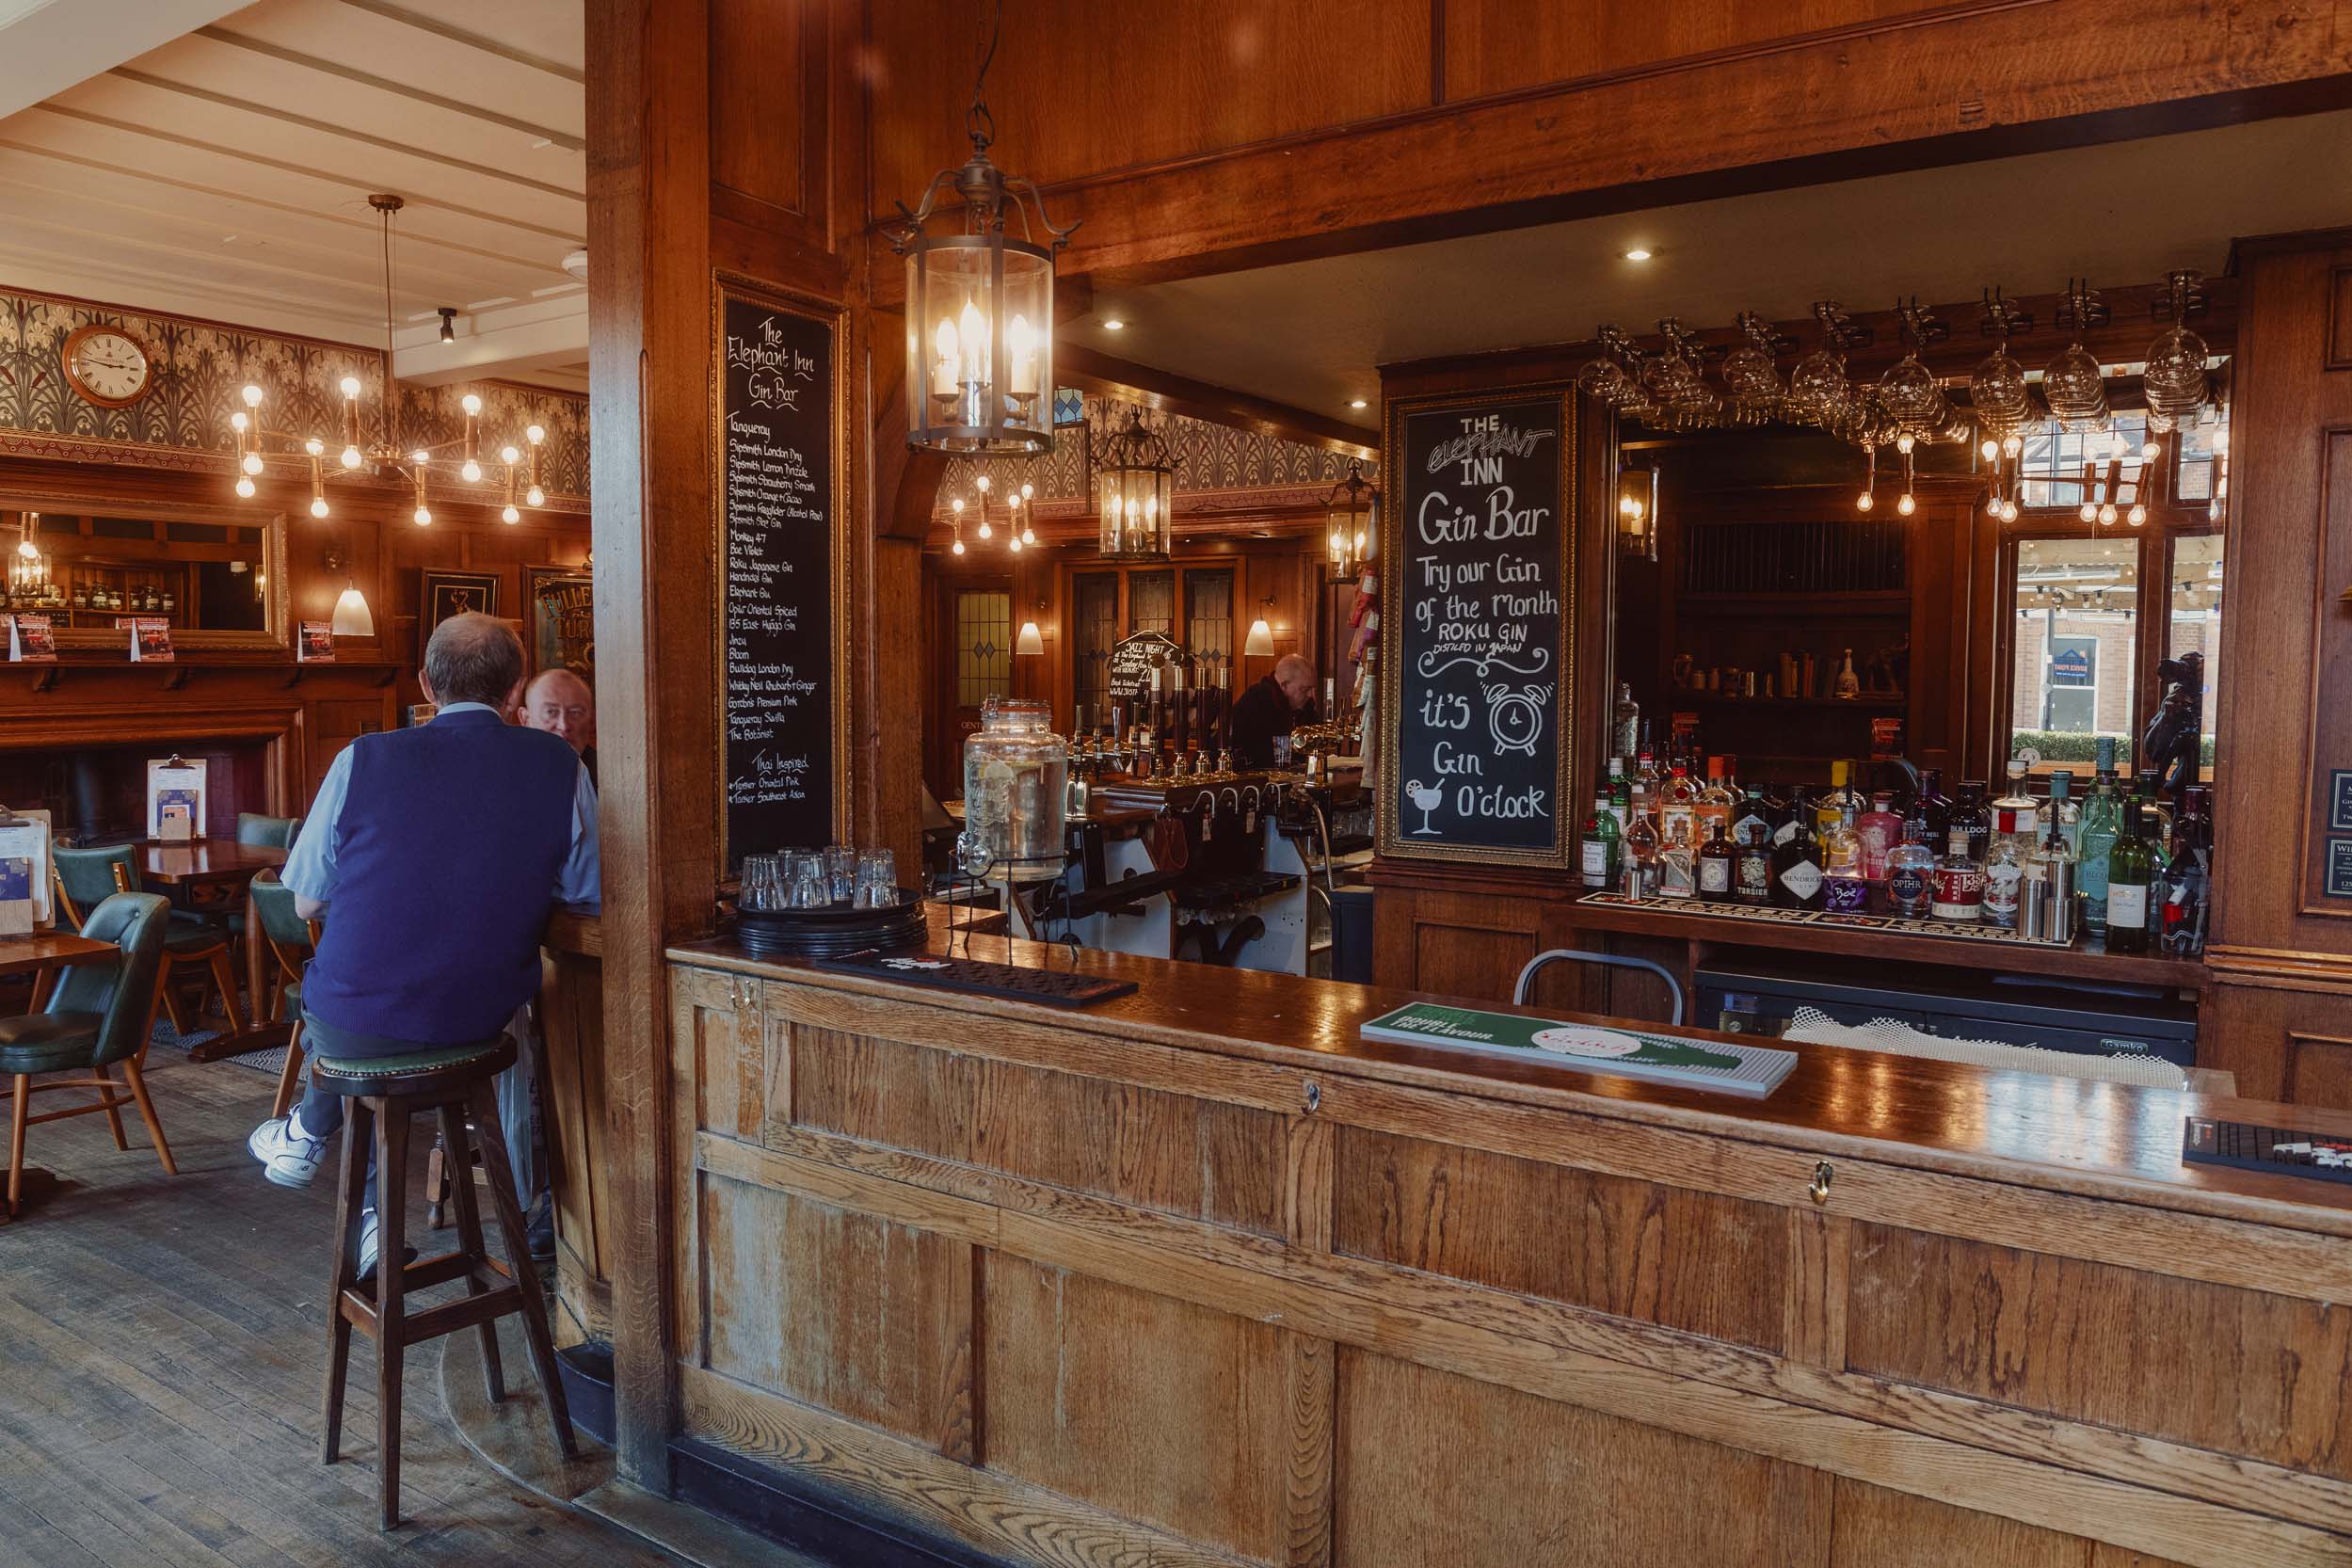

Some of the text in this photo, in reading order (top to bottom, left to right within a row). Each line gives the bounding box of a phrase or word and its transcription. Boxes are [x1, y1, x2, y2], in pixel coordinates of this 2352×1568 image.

[758, 316, 783, 344] The
[727, 335, 815, 373] Elephant Inn
[748, 373, 799, 404] Gin Bar
[725, 410, 771, 443] Tanqueray
[1460, 414, 1500, 434] THE
[728, 438, 803, 468] Sipsmith London Dry
[729, 455, 809, 479] Sipsmith Lemon Drizzle
[1460, 456, 1503, 486] INN
[728, 471, 816, 494] Sipsmith Strawberry Smash
[728, 484, 757, 503] Sipsmith
[756, 488, 779, 505] Orange
[728, 499, 757, 518] Sipsmith
[1418, 486, 1550, 545] Gin Bar
[728, 513, 755, 529] Sipsmith
[770, 518, 782, 529] Gin
[729, 528, 767, 546] Monkey 47
[729, 556, 793, 574] Roku Japanese Gin
[1416, 552, 1542, 593] Try our Gin
[541, 586, 593, 618] FULLE
[729, 584, 758, 602] Elephant
[775, 604, 798, 621] Spiced
[1415, 597, 1437, 632] of
[1446, 594, 1480, 619] the
[742, 618, 760, 630] East
[783, 618, 797, 632] Gin
[1438, 622, 1528, 645] ROKU GIN
[728, 647, 749, 660] Bloom
[1125, 642, 1165, 654] JAZZ NIGHT
[1475, 642, 1486, 653] IN
[1488, 641, 1522, 656] JAPAN
[729, 662, 793, 680] Bulldog London Dry
[1118, 659, 1139, 669] Sunday
[765, 680, 792, 692] Rhubarb
[757, 696, 782, 708] Premium
[783, 695, 798, 707] Pink
[1418, 688, 1471, 730] it's
[728, 712, 762, 731] Tanqueray
[728, 727, 775, 742] The Botanist
[751, 747, 809, 774] Thai Inspired
[1433, 741, 1483, 776] Gin
[785, 776, 800, 787] Pink
[789, 789, 806, 799] Asian
[1950, 825, 1988, 834] BULLDOG
[1892, 880, 1922, 888] OPIHR
[1390, 1020, 1417, 1030] THE
[1396, 1016, 1461, 1029] DOUBLE
[2105, 1040, 2144, 1051] Gamko
